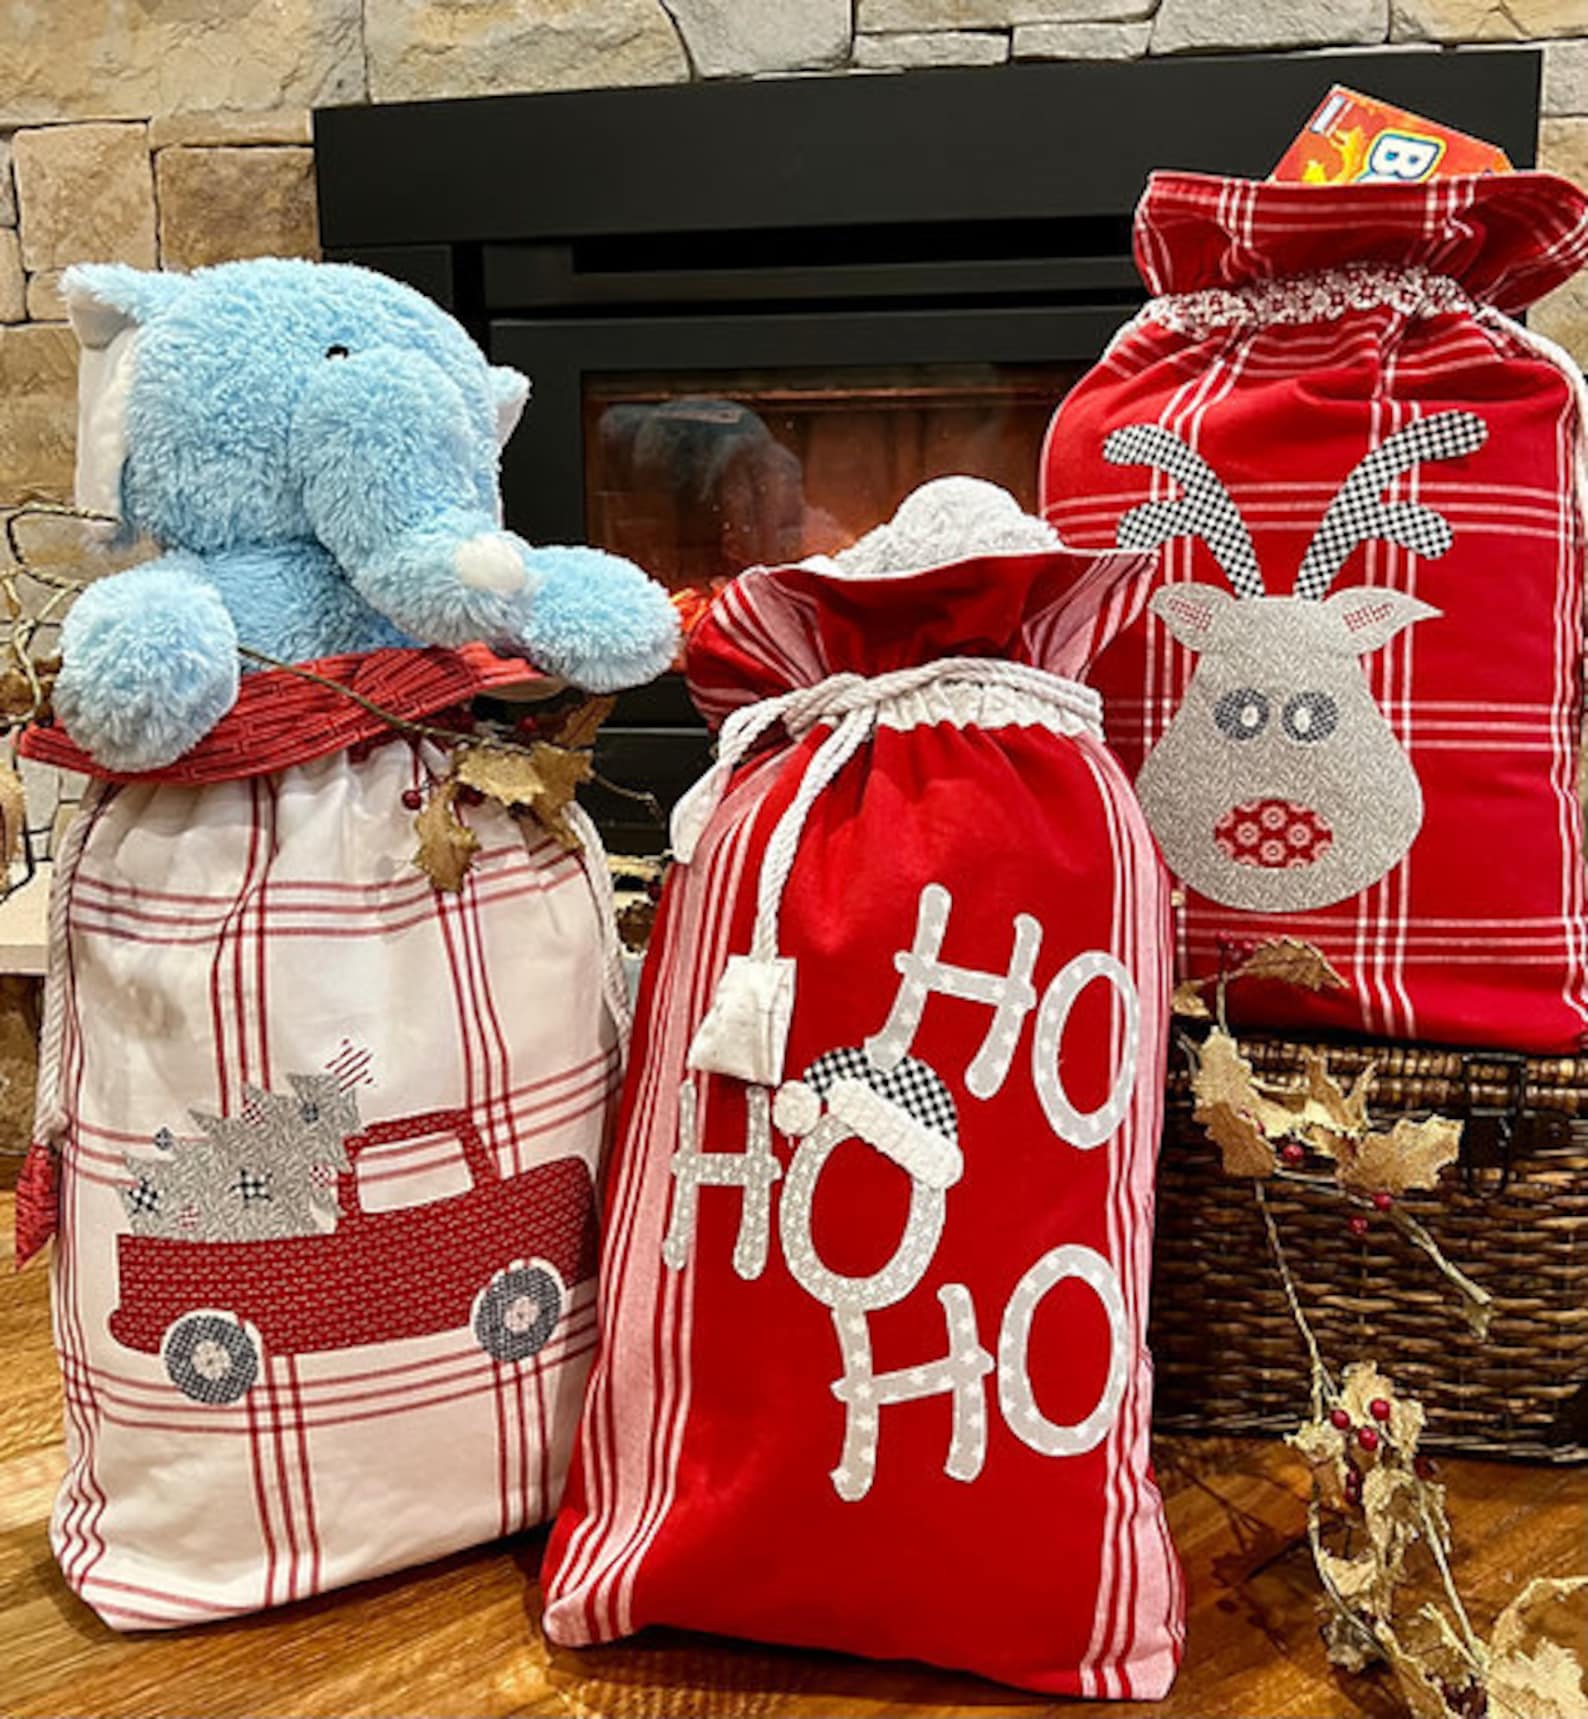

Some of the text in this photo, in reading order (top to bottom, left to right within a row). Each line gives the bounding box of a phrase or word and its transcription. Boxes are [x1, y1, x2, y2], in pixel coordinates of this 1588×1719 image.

[864, 882, 1140, 1150] HO
[662, 1078, 947, 1311] HO
[829, 1243, 1129, 1502] HO
